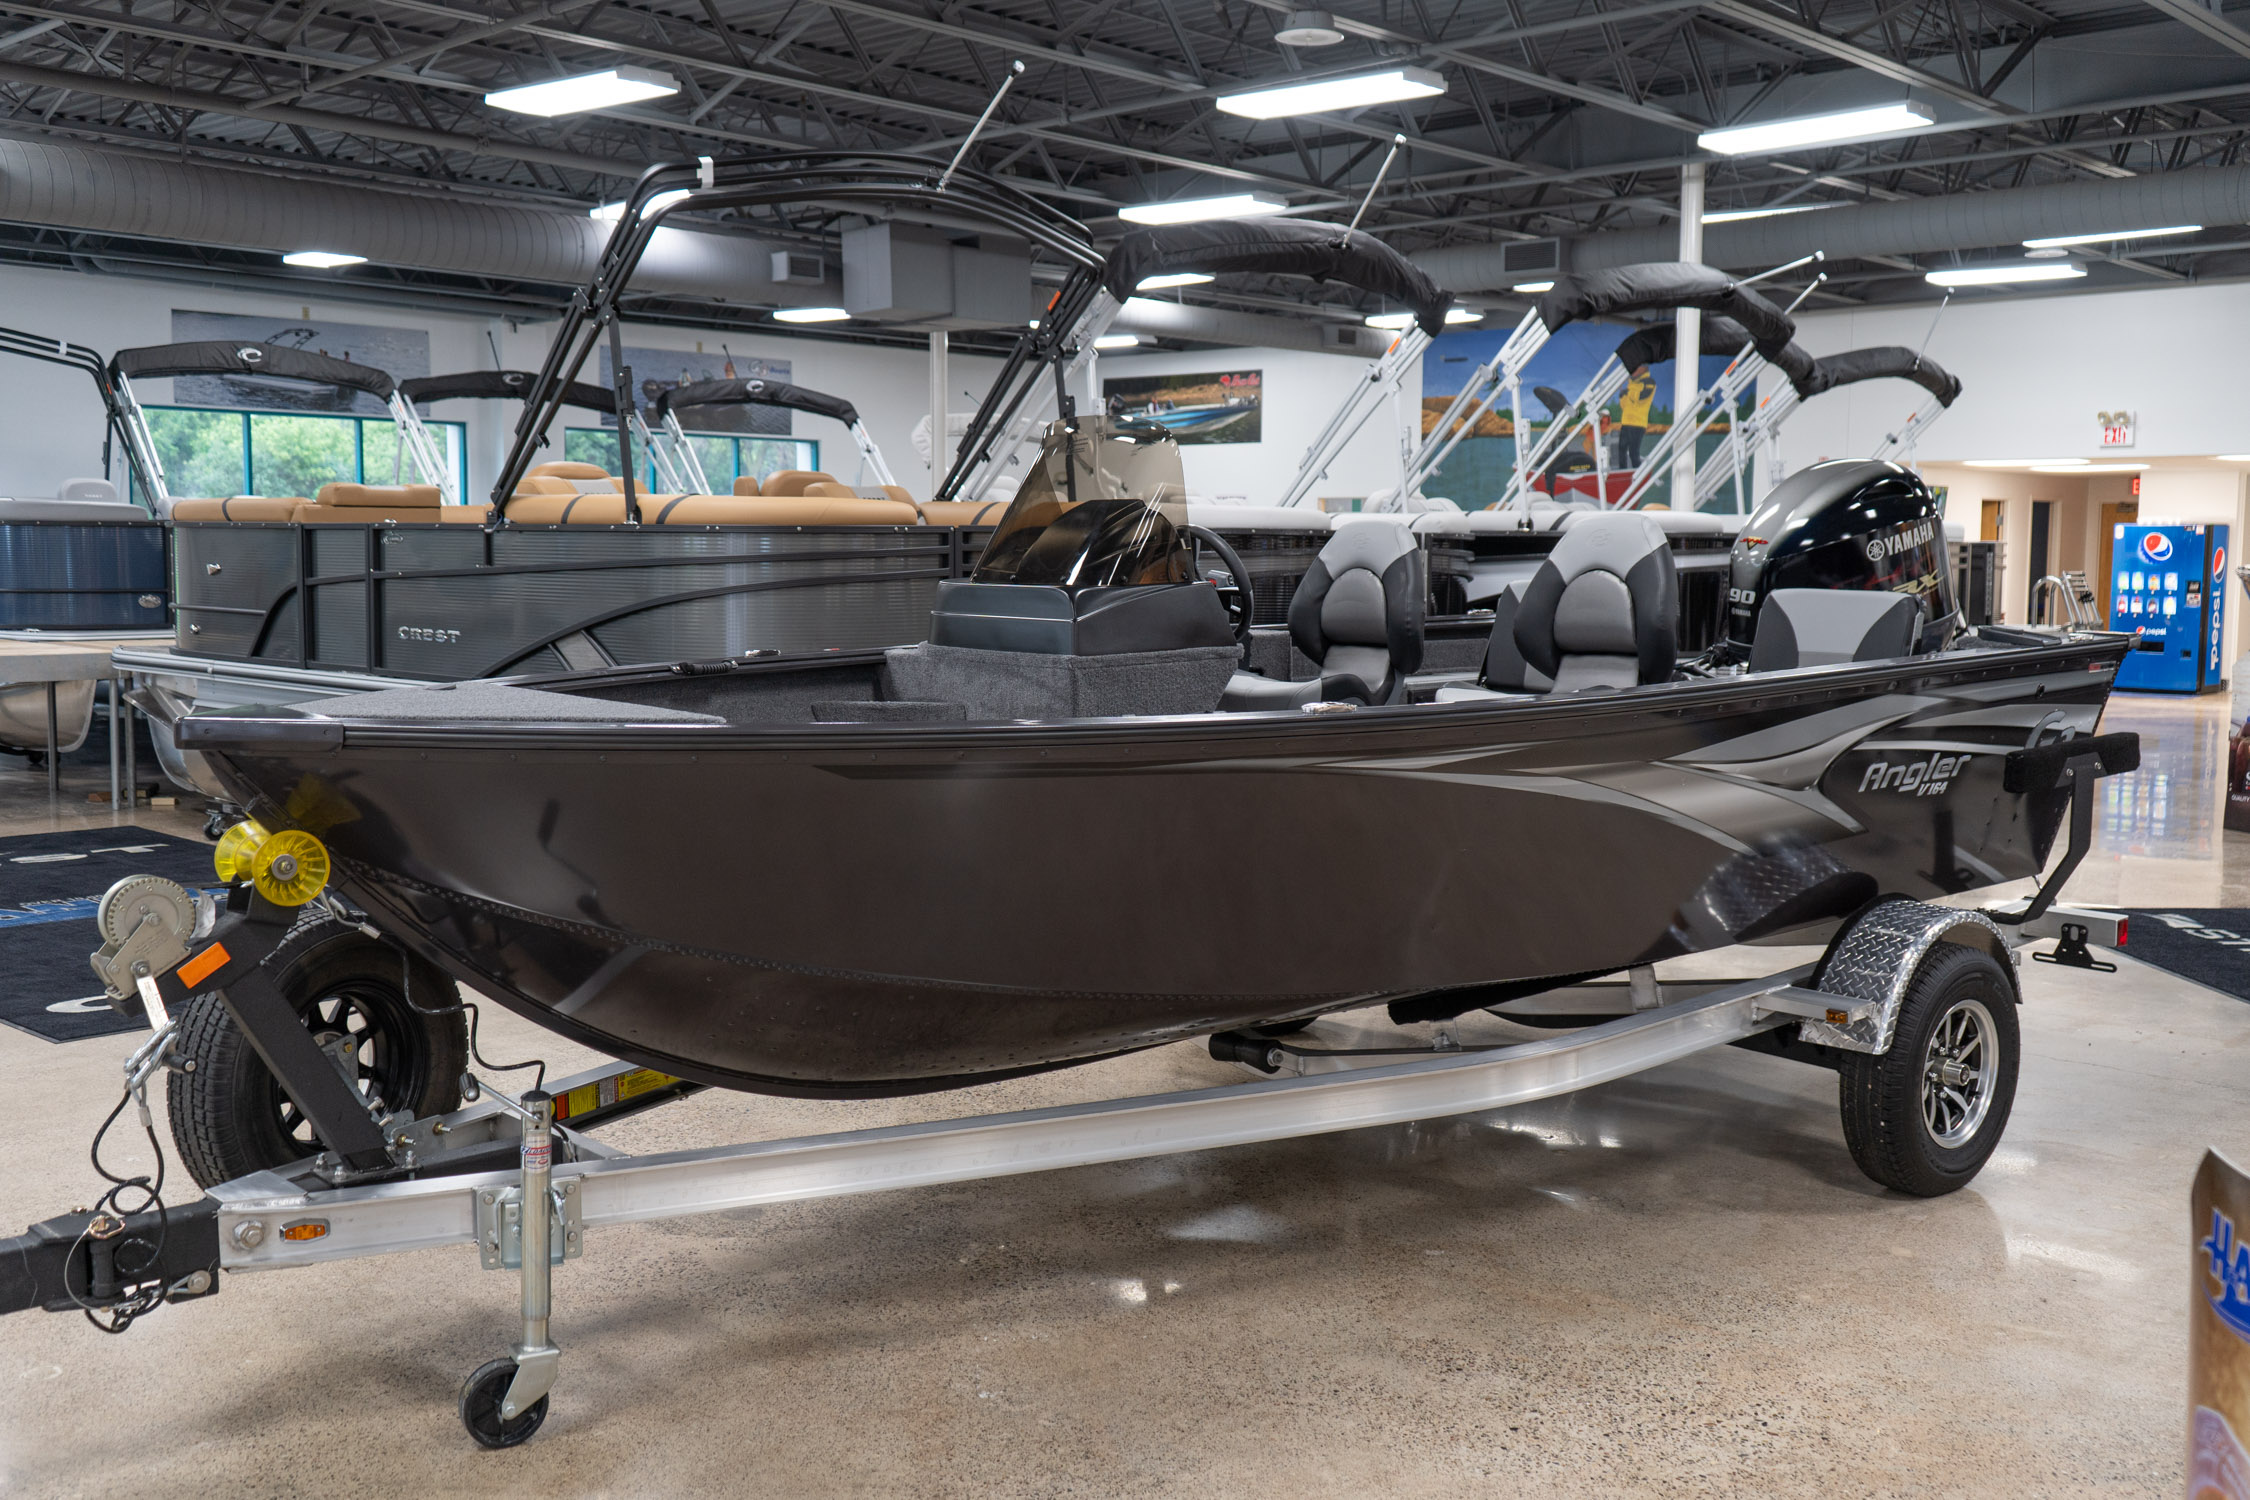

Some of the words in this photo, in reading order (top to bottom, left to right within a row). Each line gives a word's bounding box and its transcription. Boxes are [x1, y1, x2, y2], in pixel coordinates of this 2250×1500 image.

[2104, 424, 2128, 445] EXIT
[1884, 521, 1935, 556] YAMAHA
[1730, 588, 1756, 604] 90
[398, 625, 461, 644] CREST
[2210, 587, 2221, 671] pepsi
[1858, 752, 1973, 793] Angler
